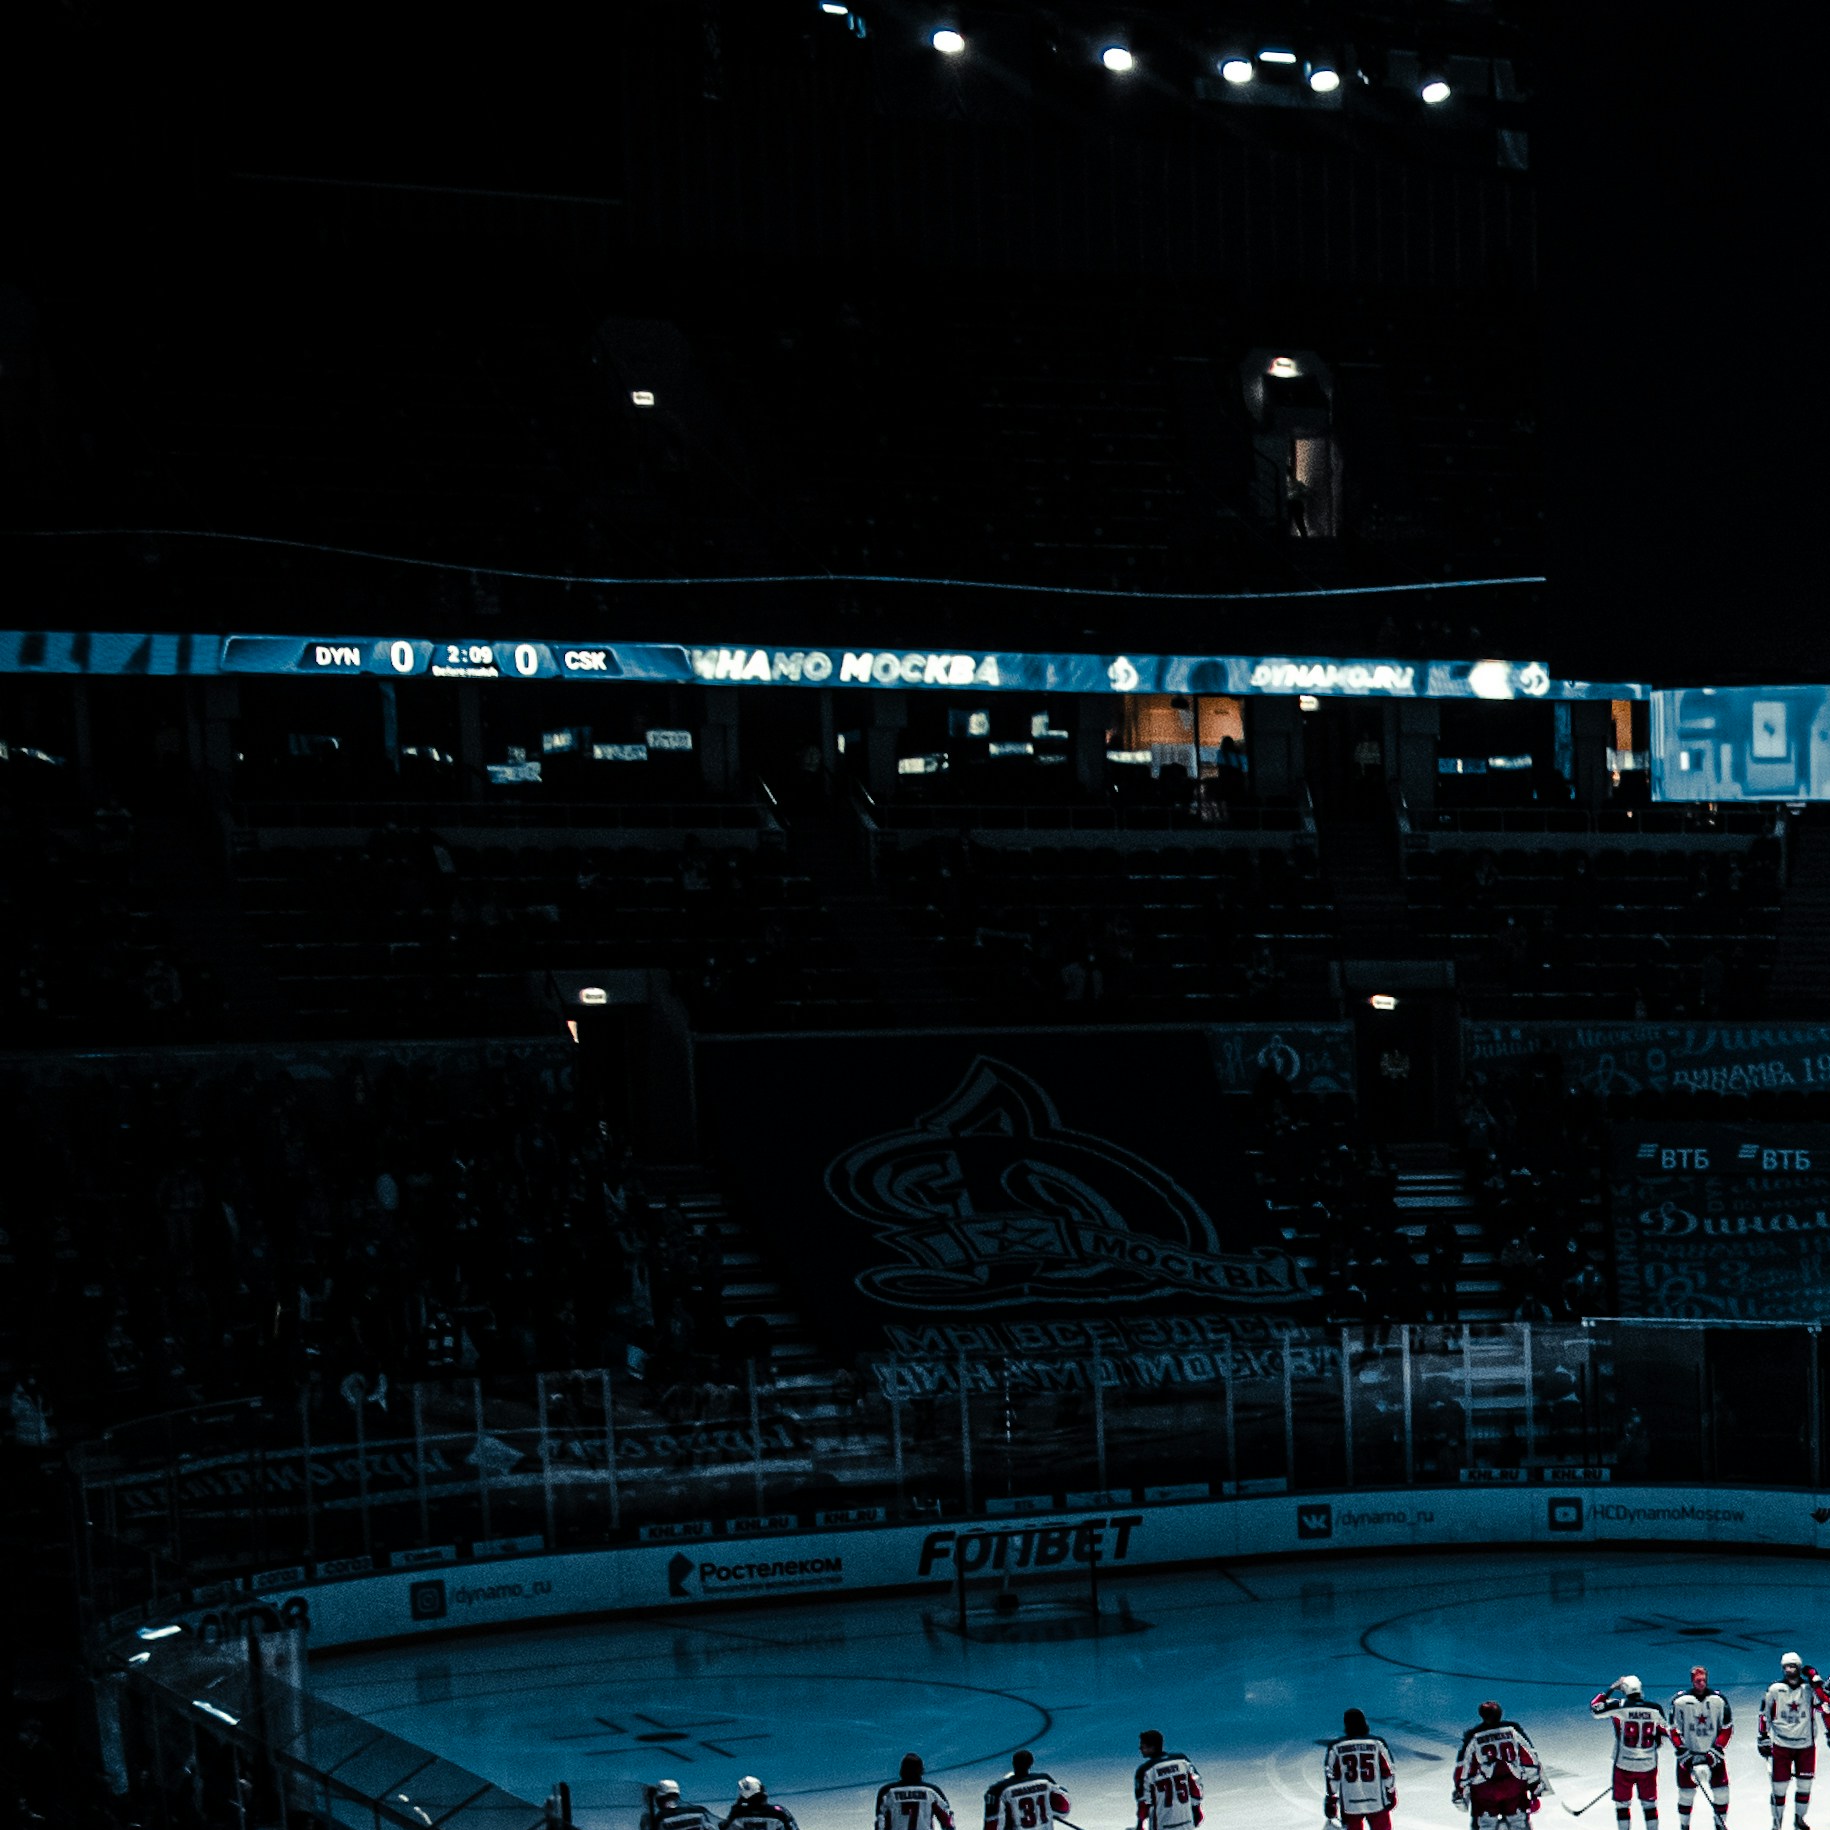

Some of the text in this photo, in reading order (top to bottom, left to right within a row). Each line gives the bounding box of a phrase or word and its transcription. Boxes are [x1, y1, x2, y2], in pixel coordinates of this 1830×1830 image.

[314, 646, 361, 666] DYN
[390, 640, 414, 673] 0
[447, 645, 493, 664] 2:09
[514, 643, 538, 676] 0
[563, 651, 607, 671] CSK
[840, 651, 1000, 687] МОСКВА
[1660, 1147, 1710, 1171] ВТБ
[1761, 1147, 1811, 1171] ВТБ
[1090, 1232, 1276, 1291] МОСКВА
[1004, 1317, 1127, 1352] ВСЕ
[1468, 1468, 1521, 1483] KHL.RU
[1550, 1468, 1604, 1483] KHL.RU
[734, 1516, 789, 1532] KHL.RU
[823, 1508, 878, 1525] KHL.RU
[648, 1523, 704, 1540] KHL.RU
[700, 1557, 843, 1584] Ростелеком
[1343, 1754, 1375, 1784] 35
[1155, 1773, 1190, 1804] 75
[1017, 1794, 1048, 1829] 31
